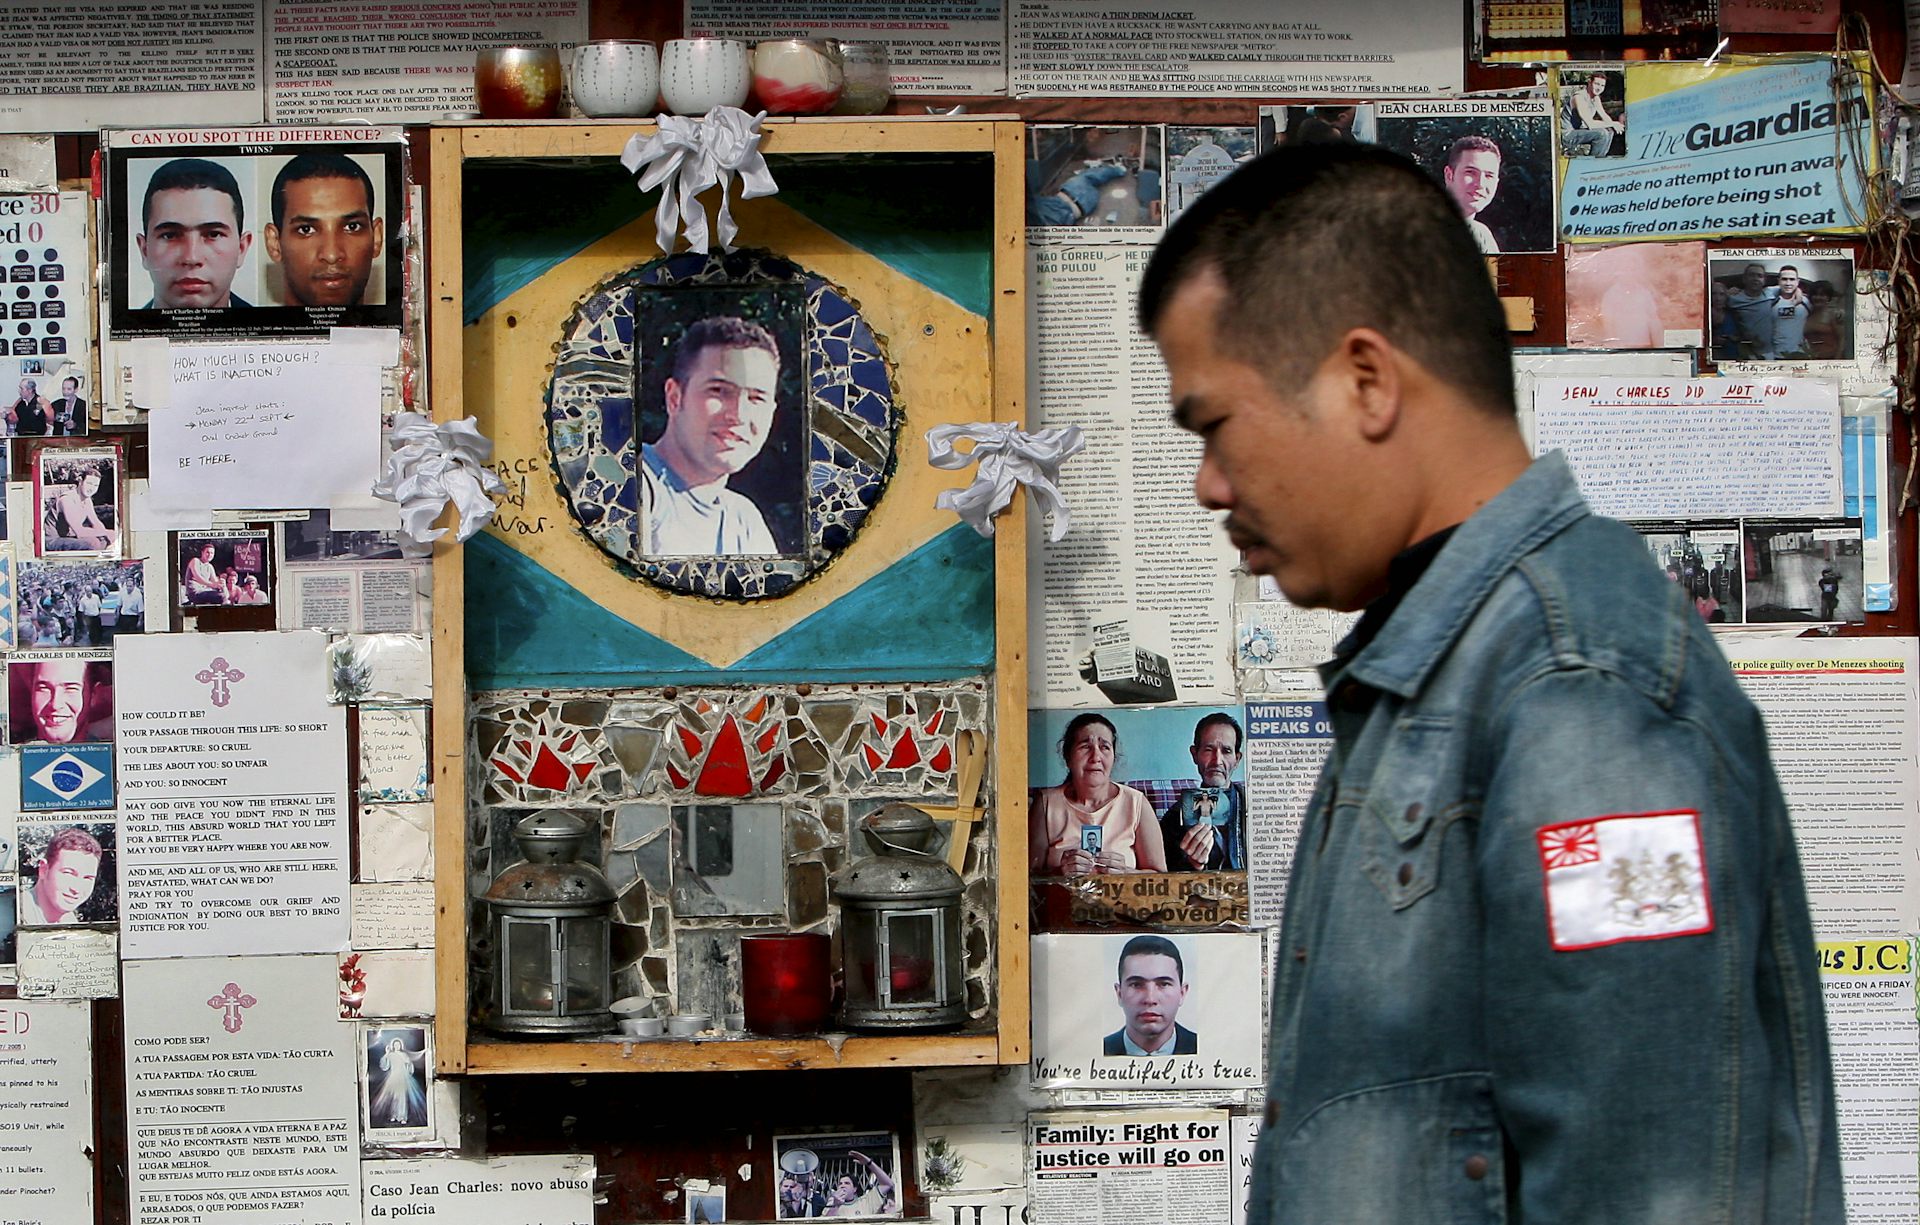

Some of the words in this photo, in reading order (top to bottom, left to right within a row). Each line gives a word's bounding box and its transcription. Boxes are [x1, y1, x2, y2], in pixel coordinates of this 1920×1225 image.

[1380, 104, 1409, 113] JEAN
[1413, 104, 1467, 112] CHARLES
[1472, 104, 1486, 112] DE
[1490, 103, 1544, 112] MENEZES
[132, 133, 161, 144] CAN
[167, 132, 198, 144] YOU
[203, 132, 239, 143] SPOT
[245, 131, 273, 142] THE
[279, 130, 381, 142] DIFFERENCE?
[240, 146, 273, 154] TWINS?
[1588, 185, 1604, 196] He
[1606, 181, 1641, 194] made
[1644, 180, 1662, 189] no
[1665, 168, 1729, 187] attempt
[1734, 167, 1750, 179] to
[1755, 163, 1786, 176] run
[1791, 154, 1847, 172] away
[30, 193, 60, 215] 30
[1581, 205, 1598, 215] He
[1601, 203, 1625, 214] was
[1628, 198, 1659, 212] held
[1662, 194, 1713, 209] before
[1717, 189, 1770, 205] being
[1774, 182, 1822, 199] shot
[1574, 224, 1594, 235] He
[1595, 225, 1620, 235] was
[1623, 219, 1656, 233] fired
[1658, 221, 1677, 231] on
[1680, 220, 1698, 230] as
[1702, 216, 1723, 229] he
[1728, 213, 1759, 227] sat
[1763, 212, 1780, 226] in
[1785, 208, 1835, 225] seat
[28, 222, 43, 243] 0
[1125, 251, 1138, 260] HE
[1062, 263, 1096, 272] PULOU
[174, 358, 197, 368] HOW
[204, 355, 237, 367] MUCH
[244, 354, 254, 364] IS
[174, 371, 200, 383] WHAT
[207, 370, 216, 380] IS
[1562, 386, 1598, 400] JEAN
[1616, 386, 1670, 398] CHARLES
[1685, 385, 1704, 398] DID
[1726, 385, 1754, 396] NOT
[1764, 385, 1788, 397] RUN
[199, 418, 227, 428] MONDAY
[260, 414, 282, 422] SEPT
[179, 458, 190, 468] BE
[199, 454, 236, 465] THERE.
[1743, 660, 1768, 670] police
[1770, 660, 1793, 670] guilty
[1869, 660, 1904, 670] shooting
[1250, 706, 1313, 718] WITNESS
[298, 723, 328, 731] SHORT
[1250, 722, 1309, 734] SPEAKS
[1133, 879, 1168, 897] did
[1852, 945, 1906, 970] J.C.
[31, 1058, 57, 1066] utterly
[164, 1071, 204, 1079] PARTIDA:
[207, 1069, 225, 1078] TÃO
[228, 1069, 257, 1077] CRUEL
[1090, 1059, 1177, 1084] beautiful,
[1181, 1062, 1203, 1079] it's
[1213, 1064, 1257, 1079] true.
[10, 1079, 33, 1088] pinned
[1035, 1125, 1114, 1145] Family:
[1123, 1124, 1178, 1143] Fight
[1187, 1122, 1219, 1139] for
[1035, 1150, 1110, 1170] justice
[1118, 1147, 1155, 1164] will
[1163, 1150, 1190, 1167] go
[1198, 1148, 1224, 1162] on
[370, 1185, 402, 1197] Caso
[409, 1184, 439, 1195] Jean
[447, 1181, 503, 1194] Charles:
[511, 1182, 543, 1191] novo
[550, 1179, 588, 1189] abuso
[371, 1205, 386, 1216] da
[391, 1203, 435, 1219] polícia
